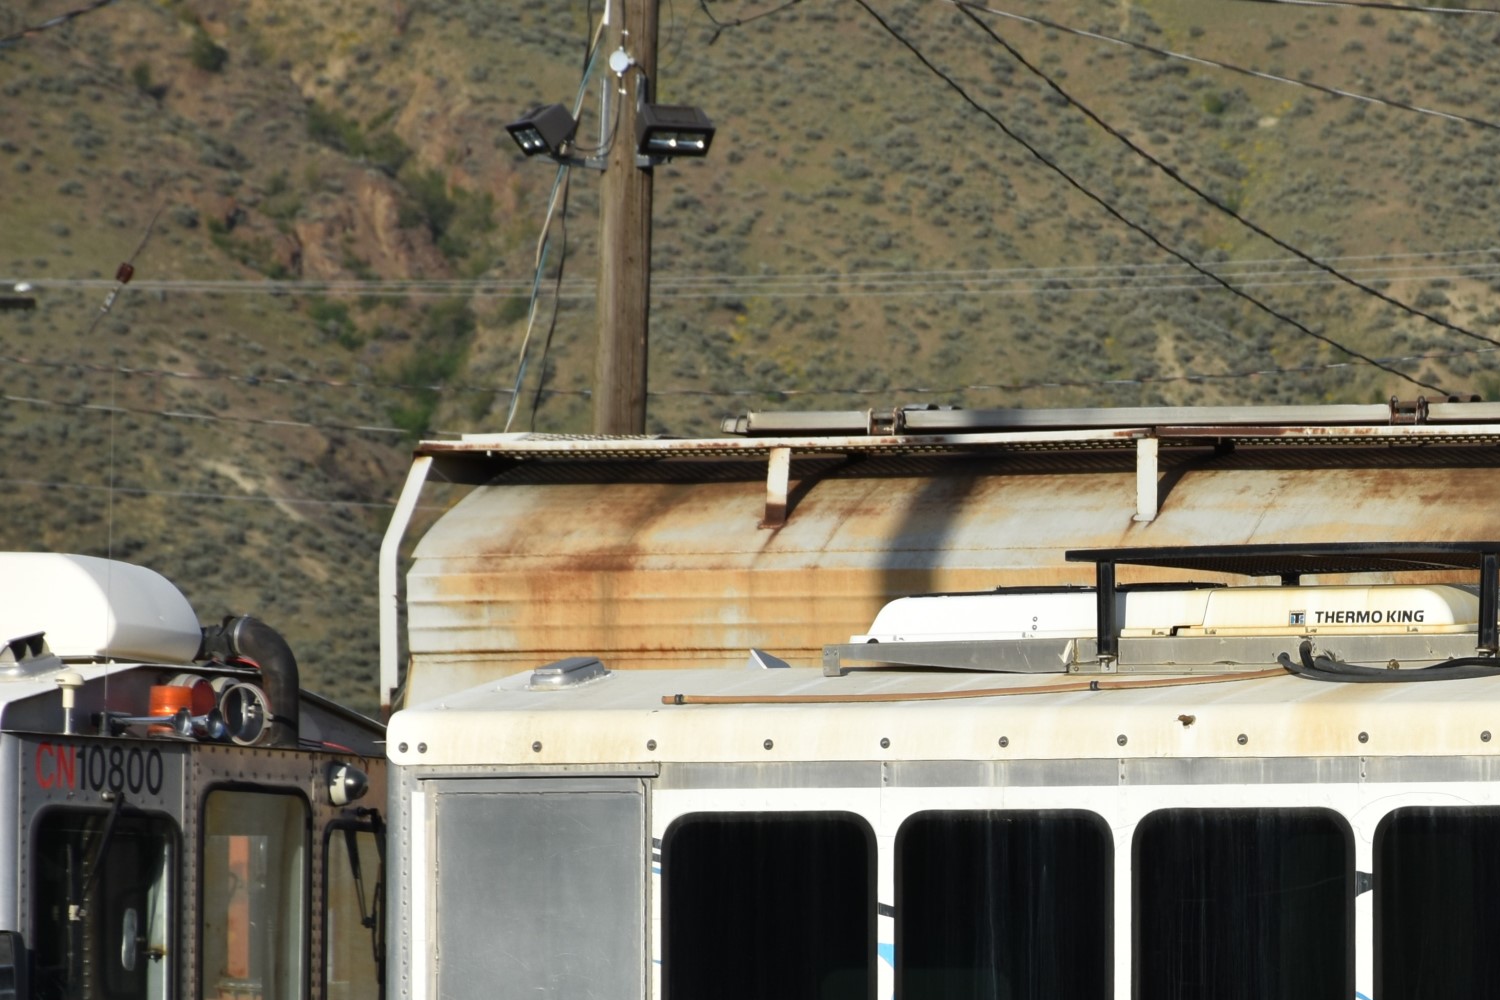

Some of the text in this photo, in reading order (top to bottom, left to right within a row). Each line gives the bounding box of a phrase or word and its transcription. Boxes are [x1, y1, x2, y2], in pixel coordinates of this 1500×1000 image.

[1315, 610, 1425, 624] THERMO KING
[34, 740, 164, 796] CN10800
